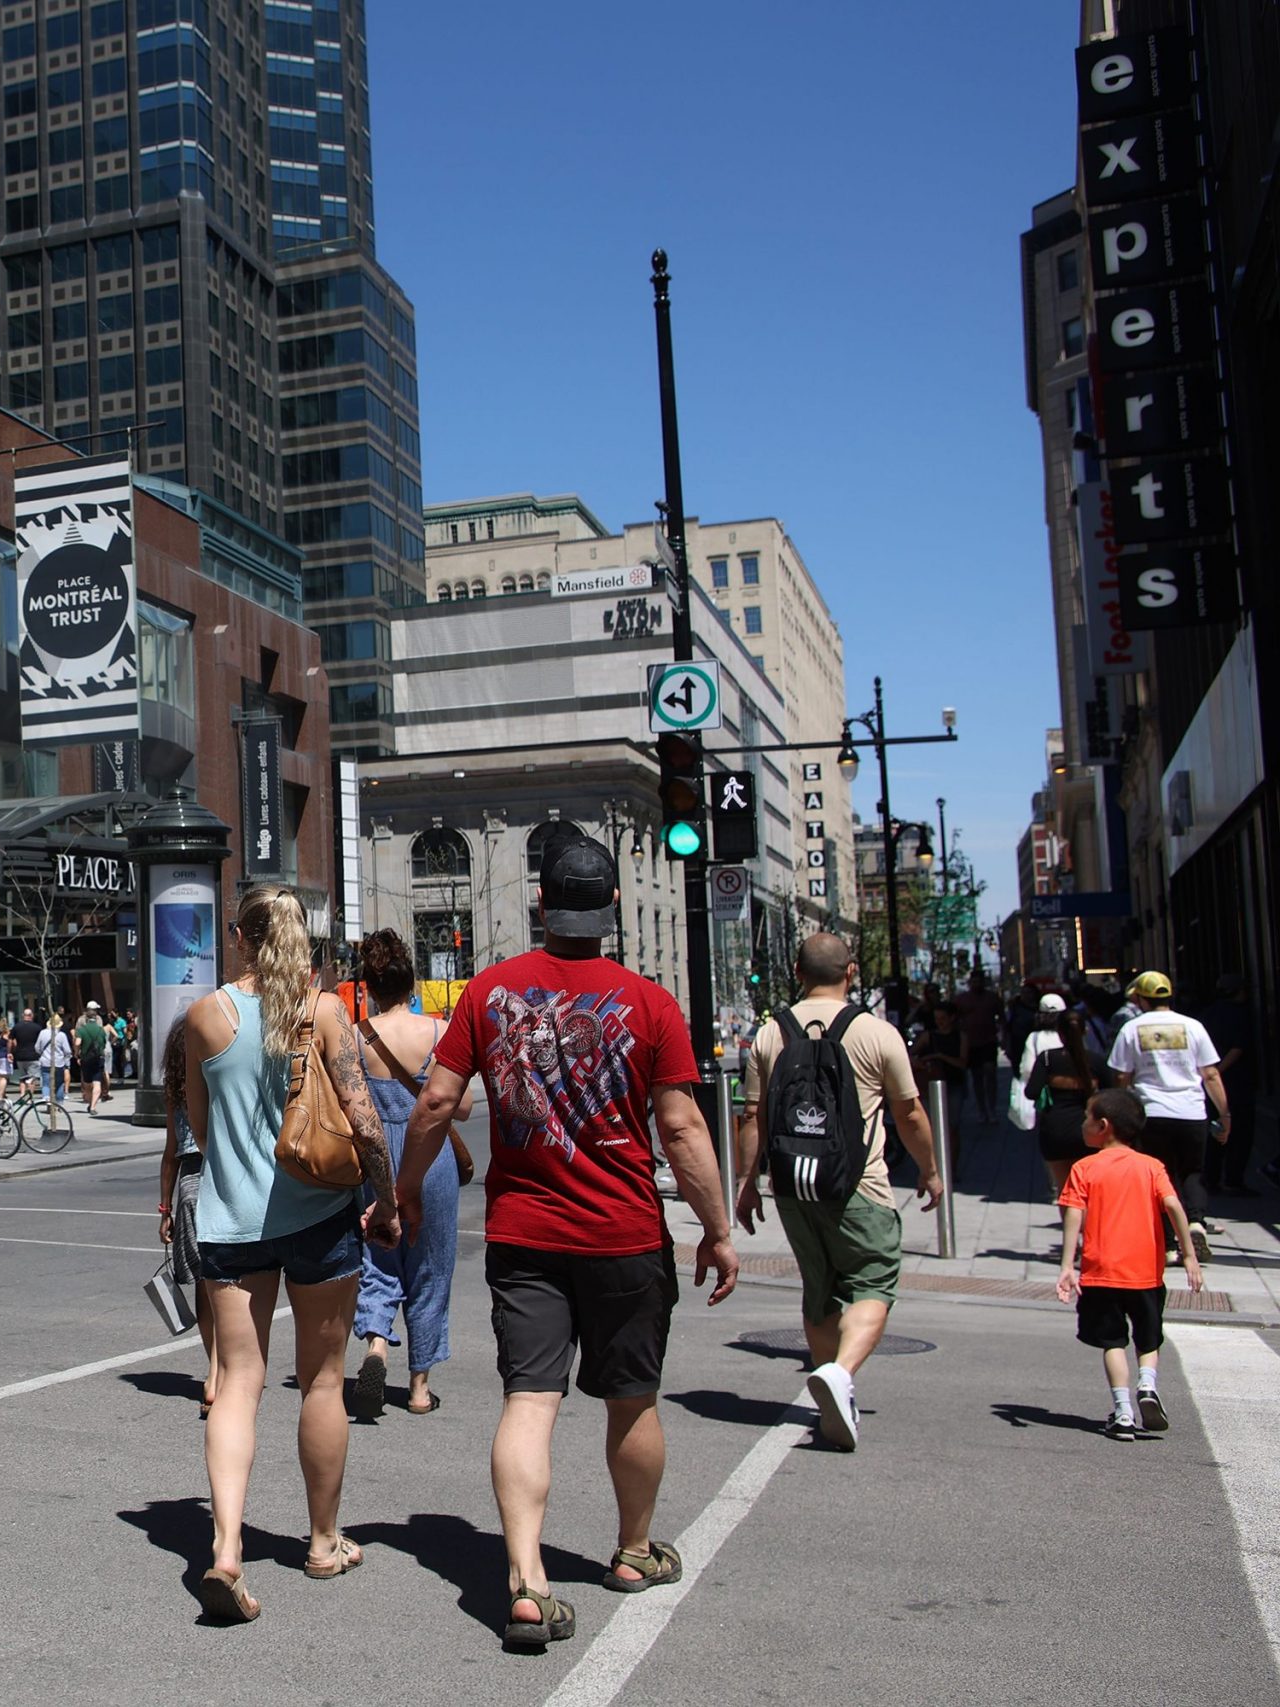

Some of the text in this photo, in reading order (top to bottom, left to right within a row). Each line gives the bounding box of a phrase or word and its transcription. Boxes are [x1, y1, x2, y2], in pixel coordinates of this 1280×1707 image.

[1090, 53, 1179, 609] experts
[58, 576, 92, 589] PLACE
[557, 575, 624, 593] Mansfield
[29, 585, 123, 612] MONTRÉAL
[50, 607, 102, 628] TRUST
[603, 604, 663, 634] EATON
[257, 740, 272, 860] Indigo Livres cadeaux enfants
[805, 764, 826, 896] EATON
[55, 852, 120, 892] PLACE
[172, 870, 197, 879] ORIS
[1031, 898, 1061, 916] Bell
[794, 1123, 826, 1135] adidas
[603, 1136, 630, 1147] HONDA
